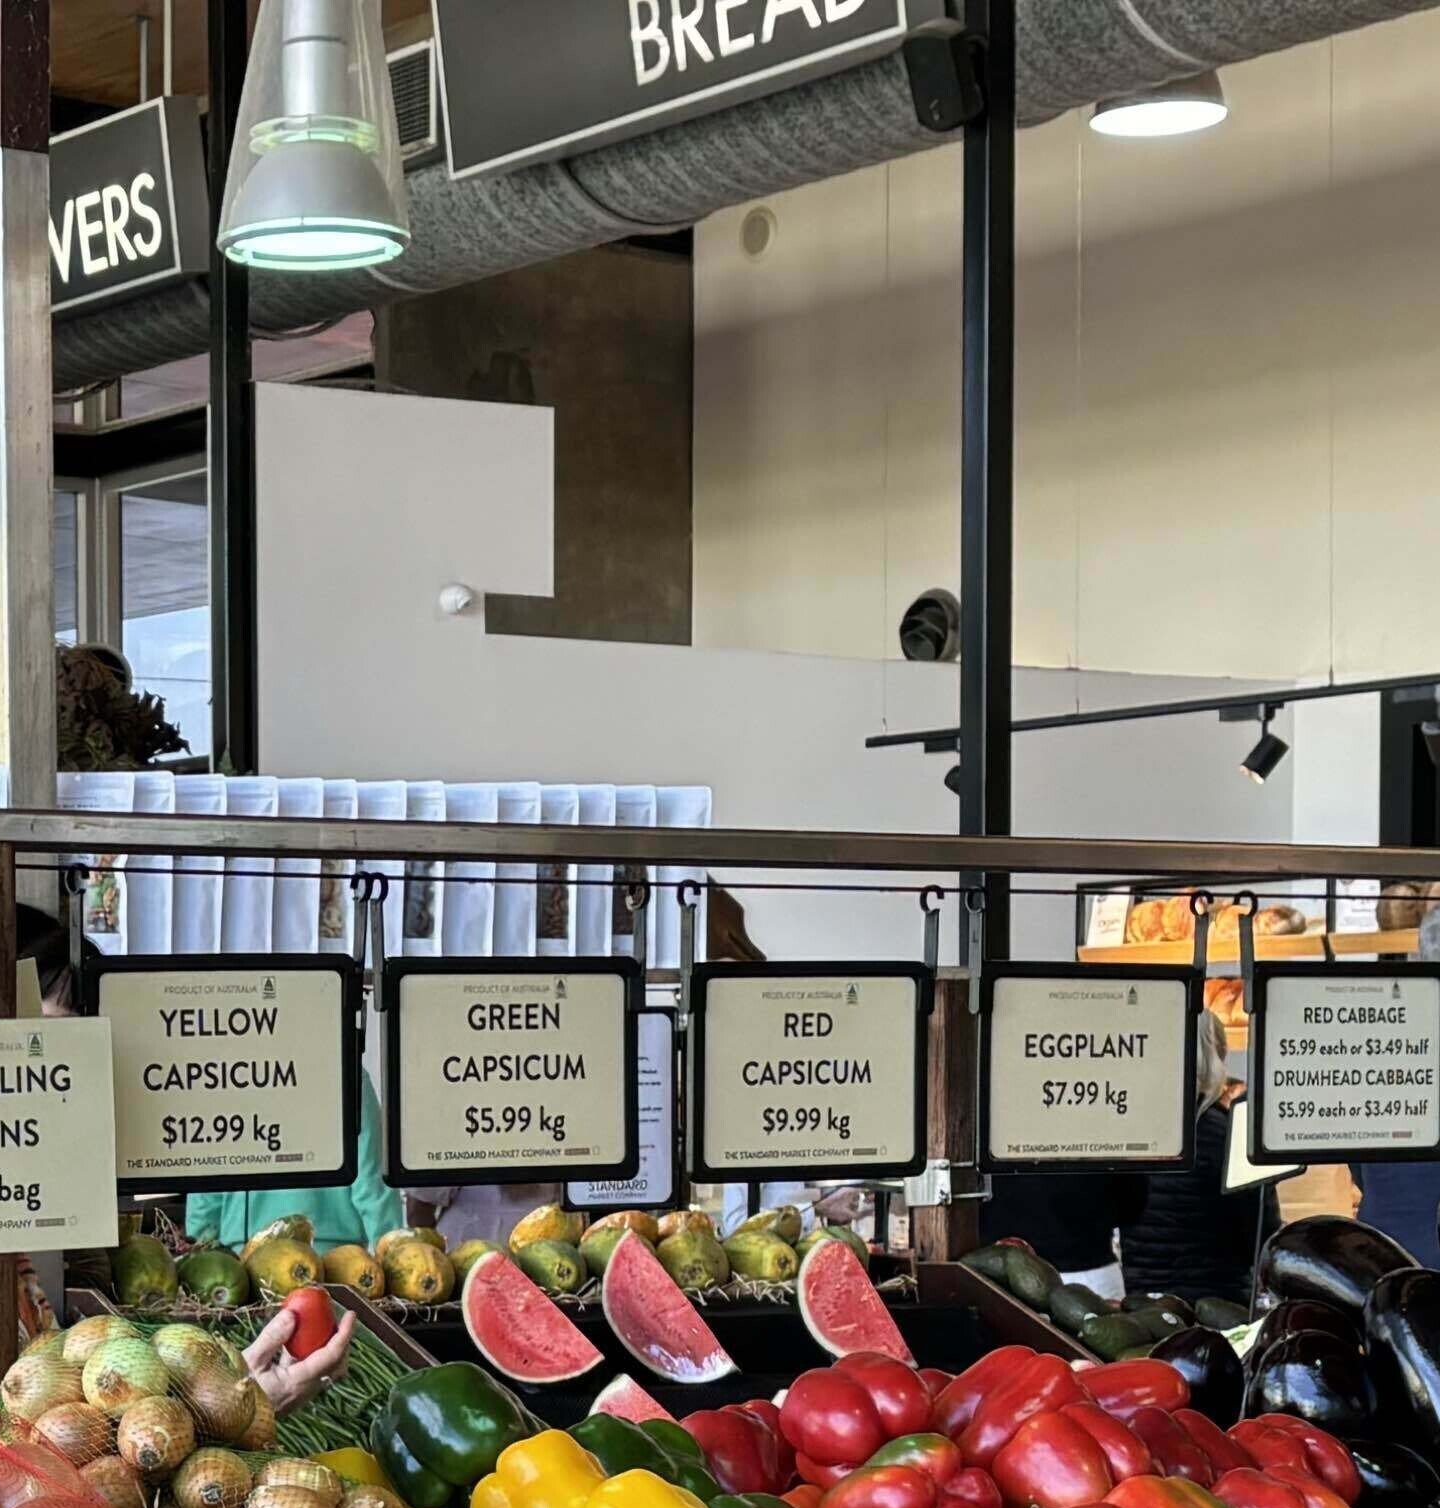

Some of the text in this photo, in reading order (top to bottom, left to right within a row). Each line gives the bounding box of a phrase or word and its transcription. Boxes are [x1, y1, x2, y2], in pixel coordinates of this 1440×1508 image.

[160, 1007, 278, 1037] YELLOW
[467, 1002, 561, 1031] GREEN
[784, 1013, 833, 1037] RED
[1304, 1007, 1406, 1024] RED CABBAGE
[1024, 1034, 1148, 1058] EGGPLANT
[1279, 1038, 1429, 1057] $5.99 each or $3.49 half
[143, 1060, 297, 1091] CAPSICUM
[442, 1054, 586, 1083] CAPSICUM
[742, 1060, 872, 1085] CAPSICUM
[1274, 1069, 1433, 1086] DRUMHEAD CABBAGE
[1042, 1081, 1127, 1114] $7.99 kg
[1278, 1100, 1428, 1119] $5.99 each or $3.49 half
[162, 1114, 281, 1151] $12.99 kg
[465, 1105, 566, 1142] $5.99 kg
[763, 1107, 850, 1139] $9.99 kg
[145, 1157, 191, 1168] STANDARD
